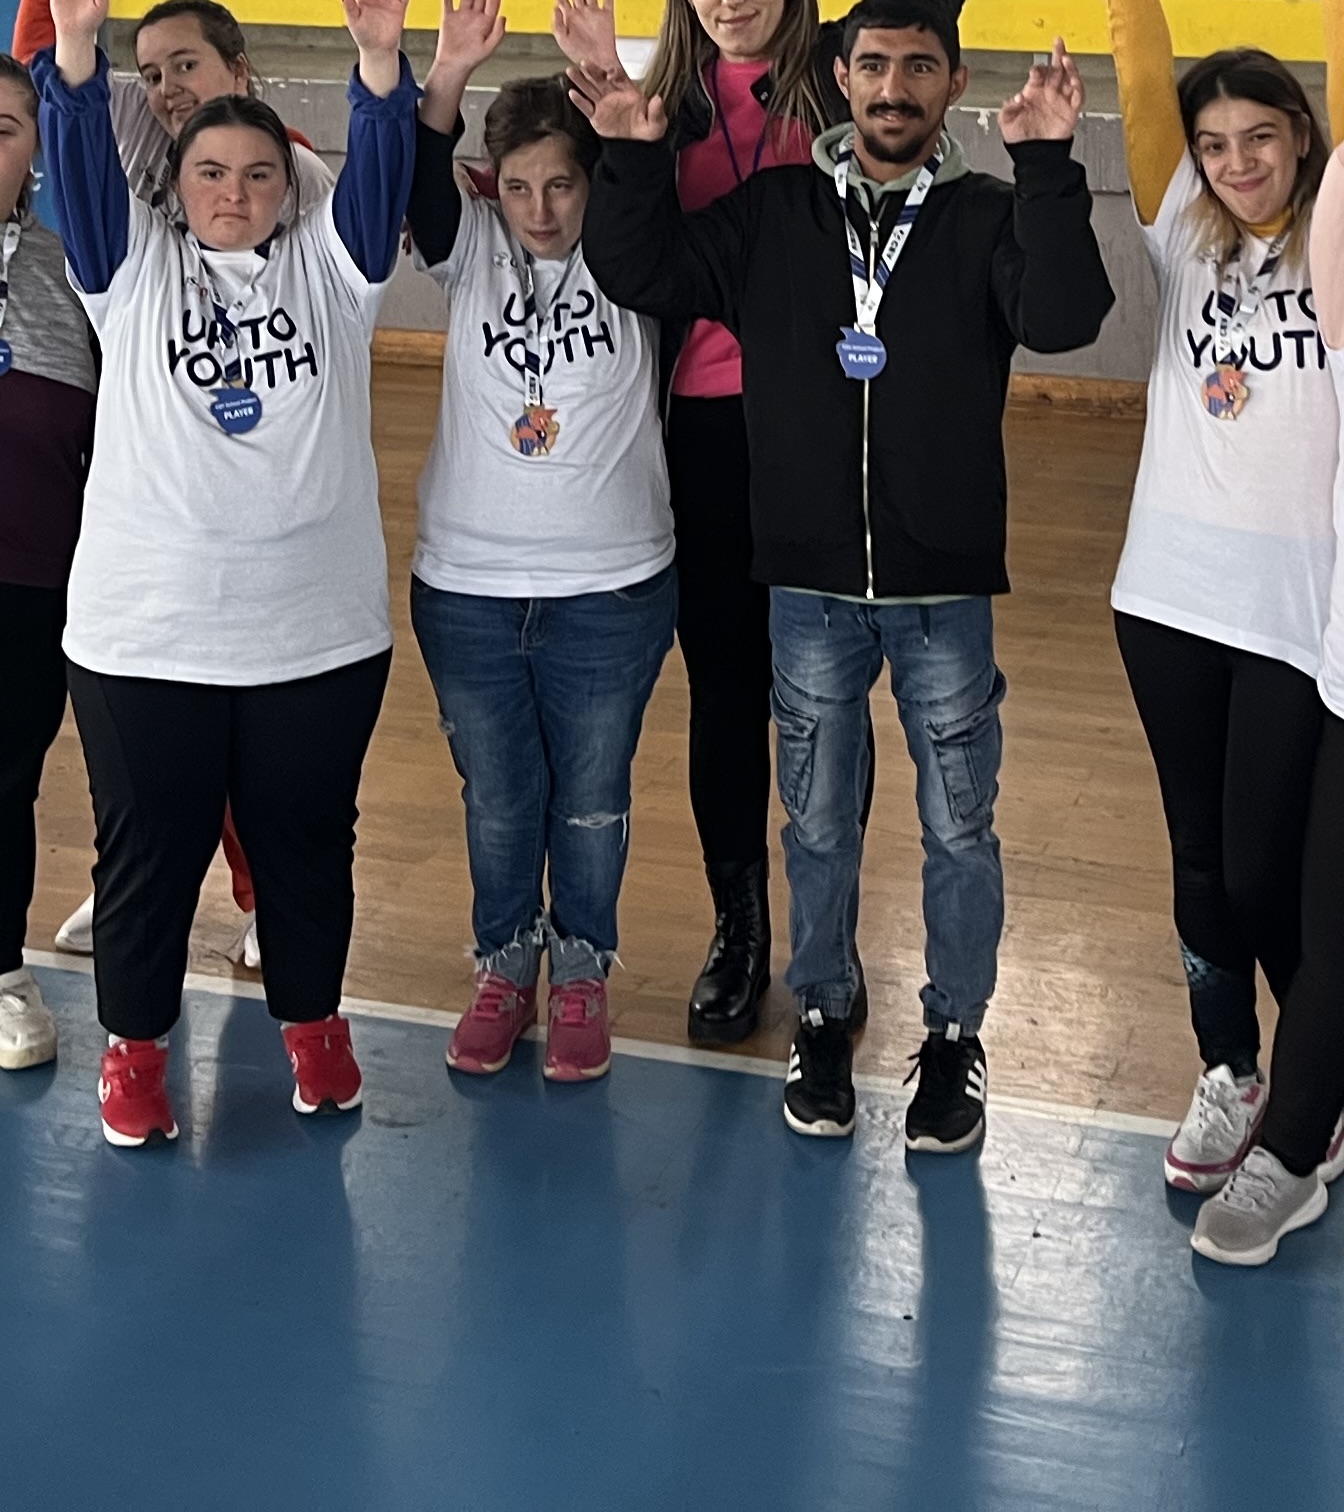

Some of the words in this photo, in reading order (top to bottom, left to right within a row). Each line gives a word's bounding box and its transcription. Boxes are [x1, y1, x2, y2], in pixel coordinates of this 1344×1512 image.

[238, 308, 297, 349] TO
[848, 353, 878, 365] PLAYER
[223, 406, 254, 421] PLAYER
